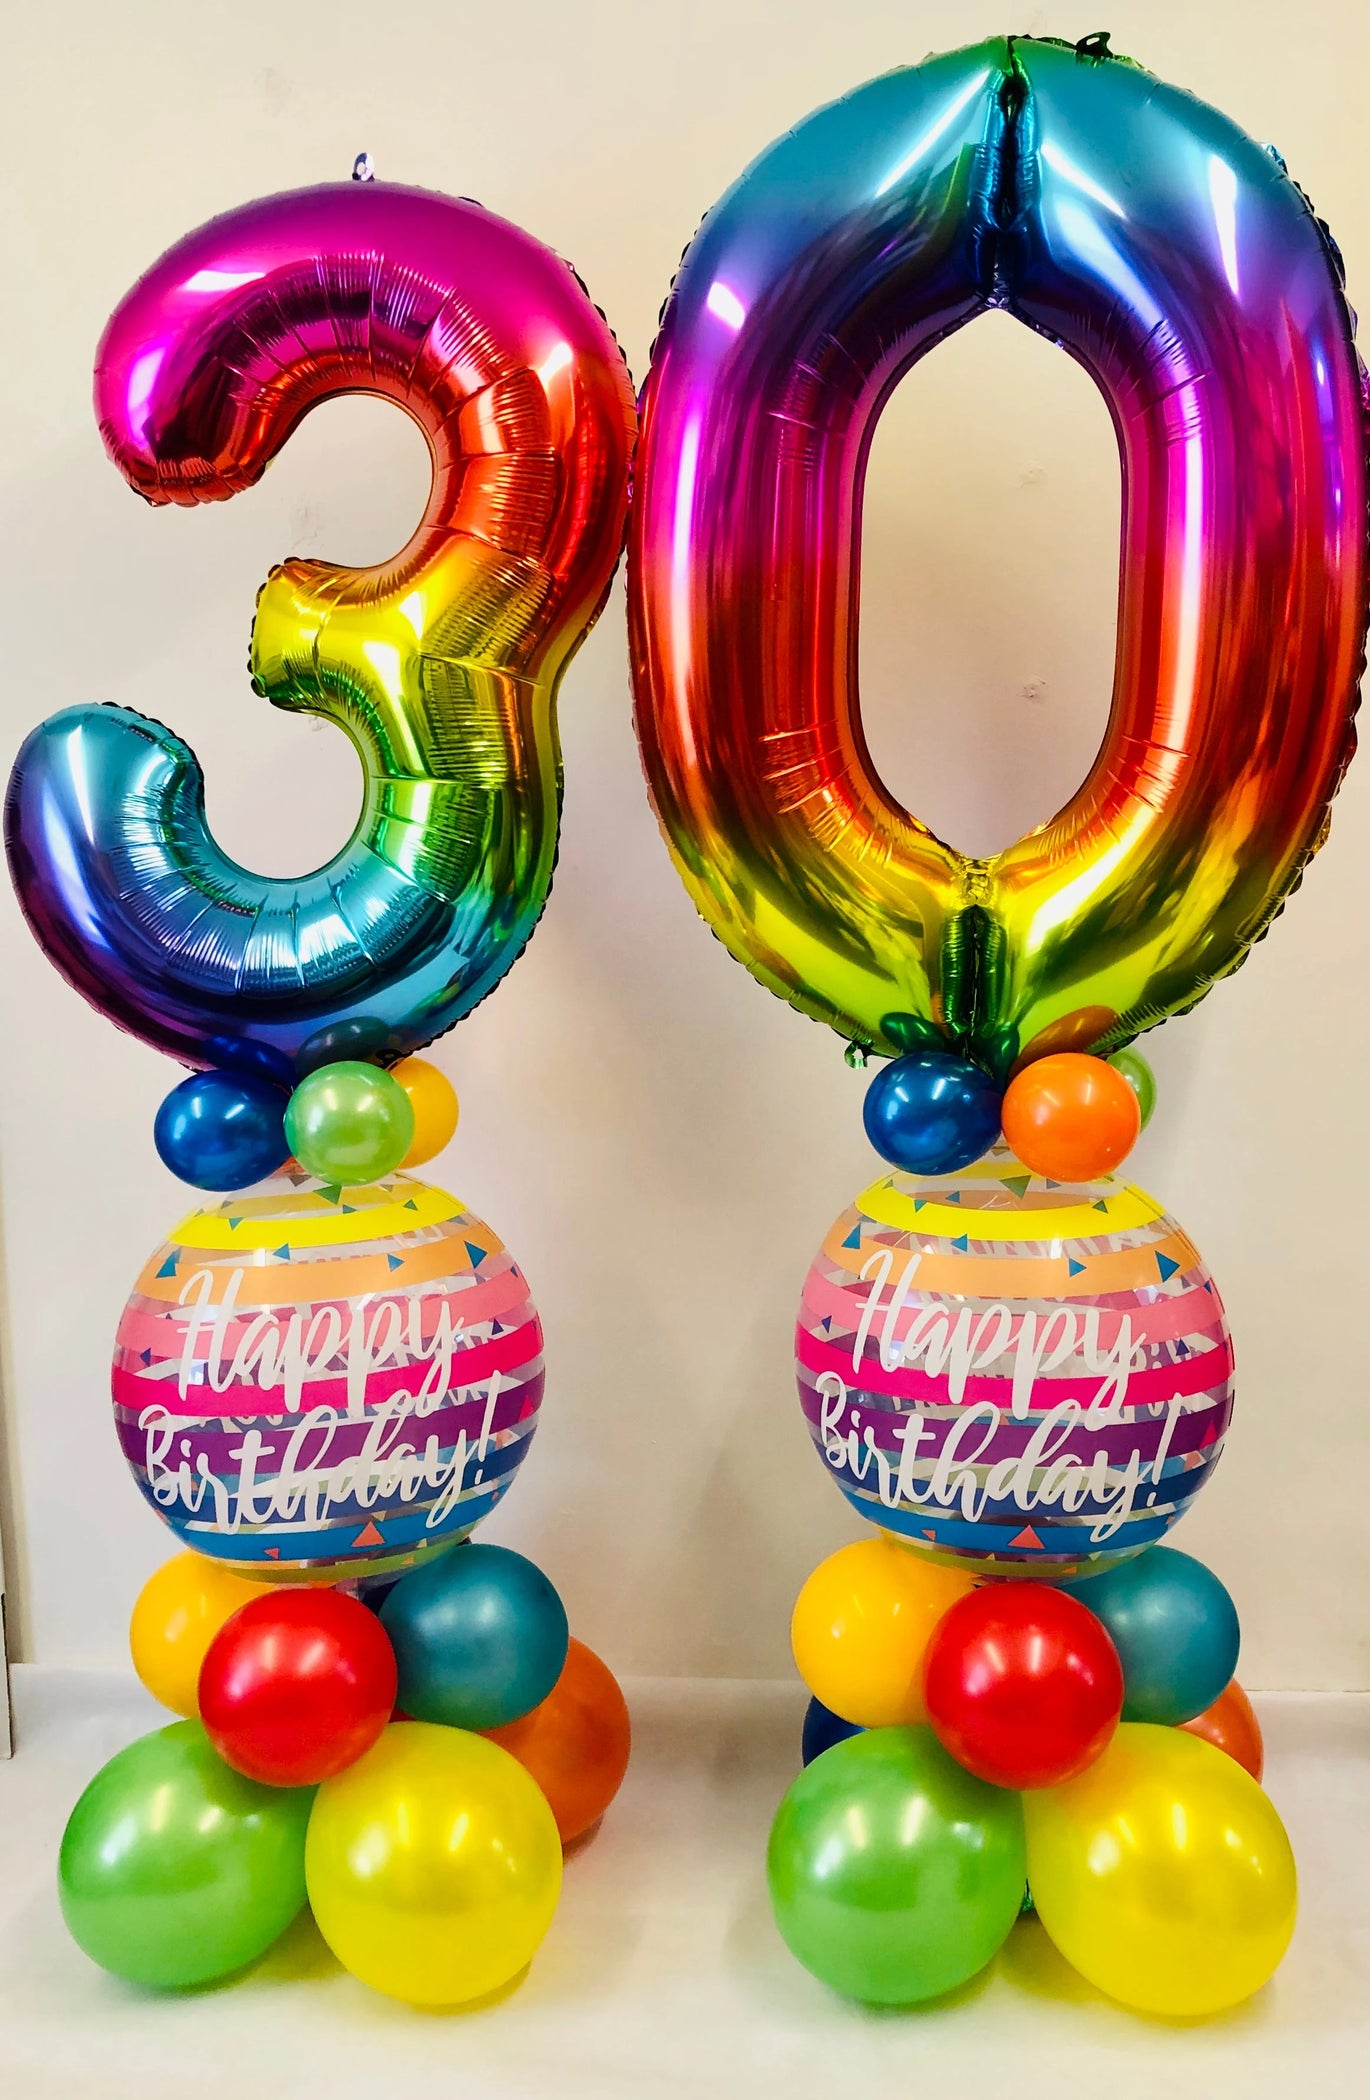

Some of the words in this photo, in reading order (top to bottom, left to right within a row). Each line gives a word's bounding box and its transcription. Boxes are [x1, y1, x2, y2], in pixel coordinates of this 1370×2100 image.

[176, 1268, 464, 1420] Happy
[853, 1249, 1147, 1431] Happy
[138, 1370, 502, 1535] Birthday!
[814, 1370, 1186, 1543] Birthday!
